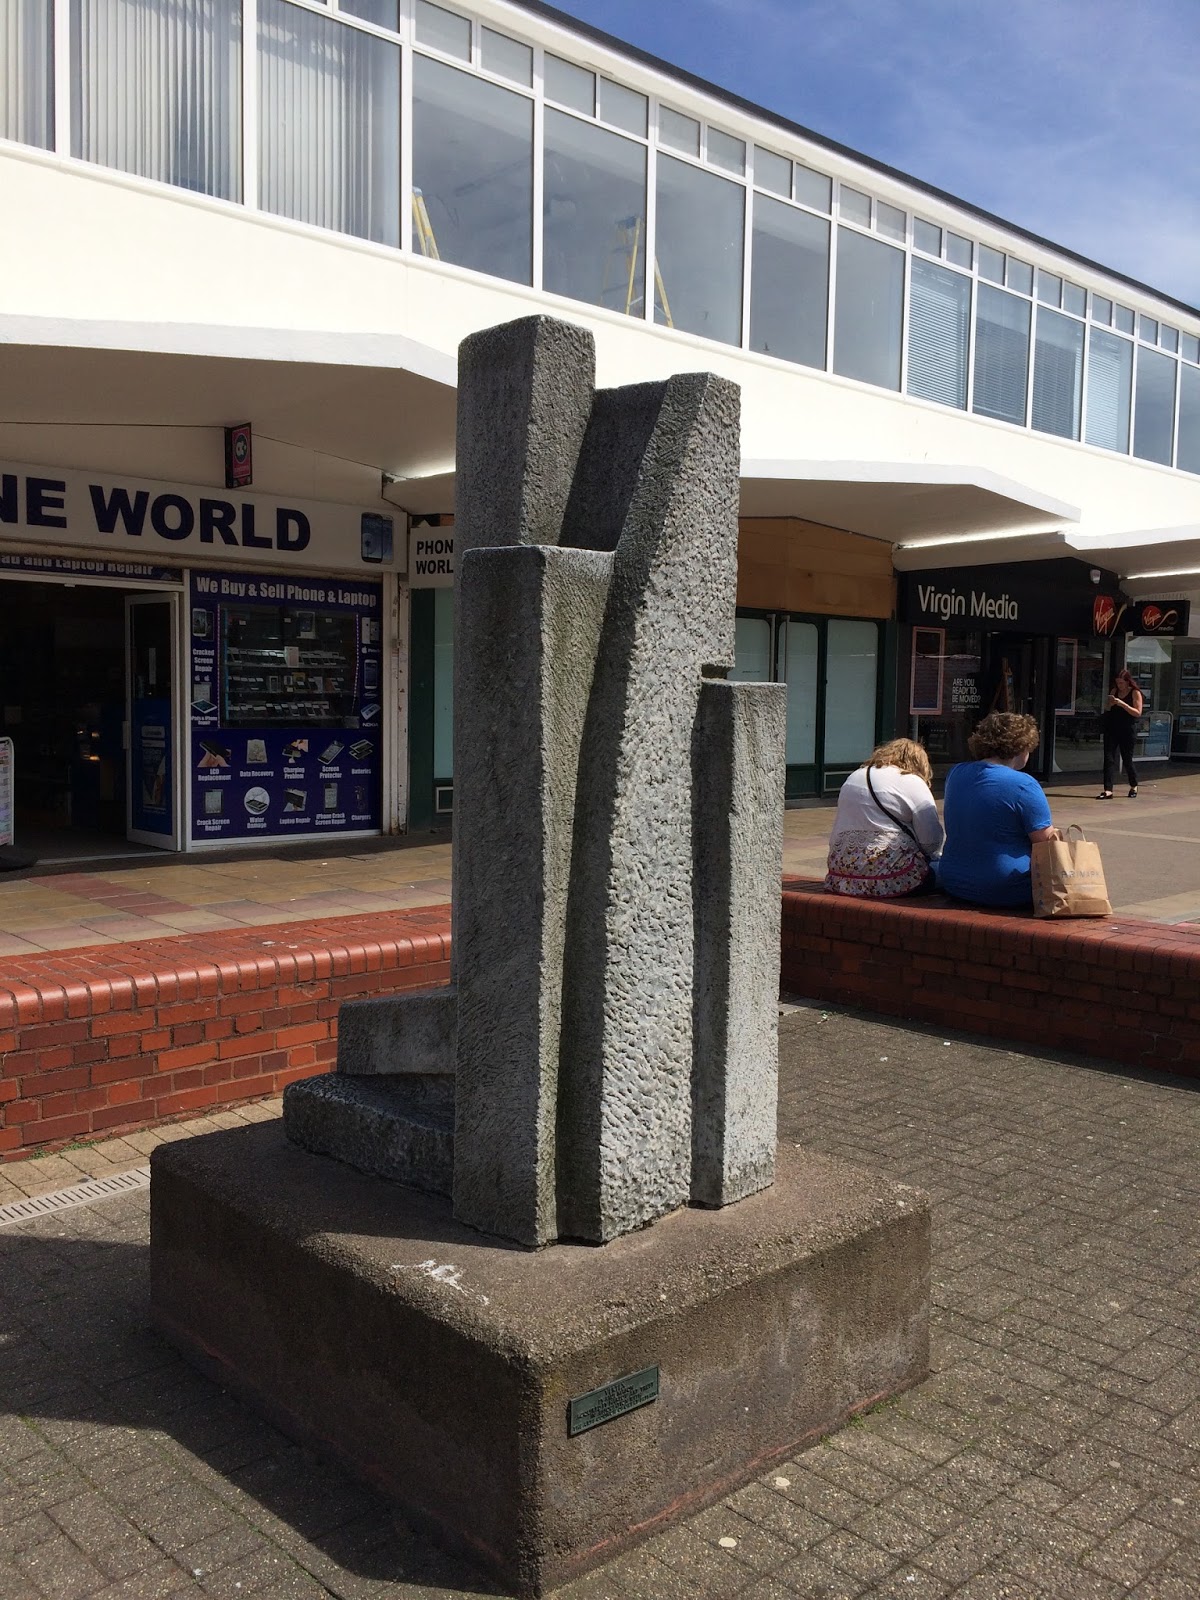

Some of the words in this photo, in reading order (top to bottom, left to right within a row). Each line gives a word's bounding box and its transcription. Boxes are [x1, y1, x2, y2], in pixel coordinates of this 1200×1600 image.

[88, 484, 311, 552] WORLD
[416, 539, 454, 555] PHON
[416, 560, 454, 574] WORL
[197, 577, 219, 593] We
[221, 579, 246, 597] Buy
[248, 584, 257, 597] &
[260, 582, 285, 598] Sell
[287, 586, 325, 602] Phone
[327, 590, 336, 602] &
[338, 589, 376, 607] Laptop
[918, 585, 966, 620] Virgin
[970, 590, 1018, 620] Media
[1095, 600, 1115, 635] Virgin
[1144, 610, 1161, 626] Virgin
[195, 665, 213, 673] Repair
[953, 678, 963, 686] ARE
[952, 695, 958, 703] BE
[959, 695, 981, 703] MOVED?
[251, 770, 274, 778] Recovery
